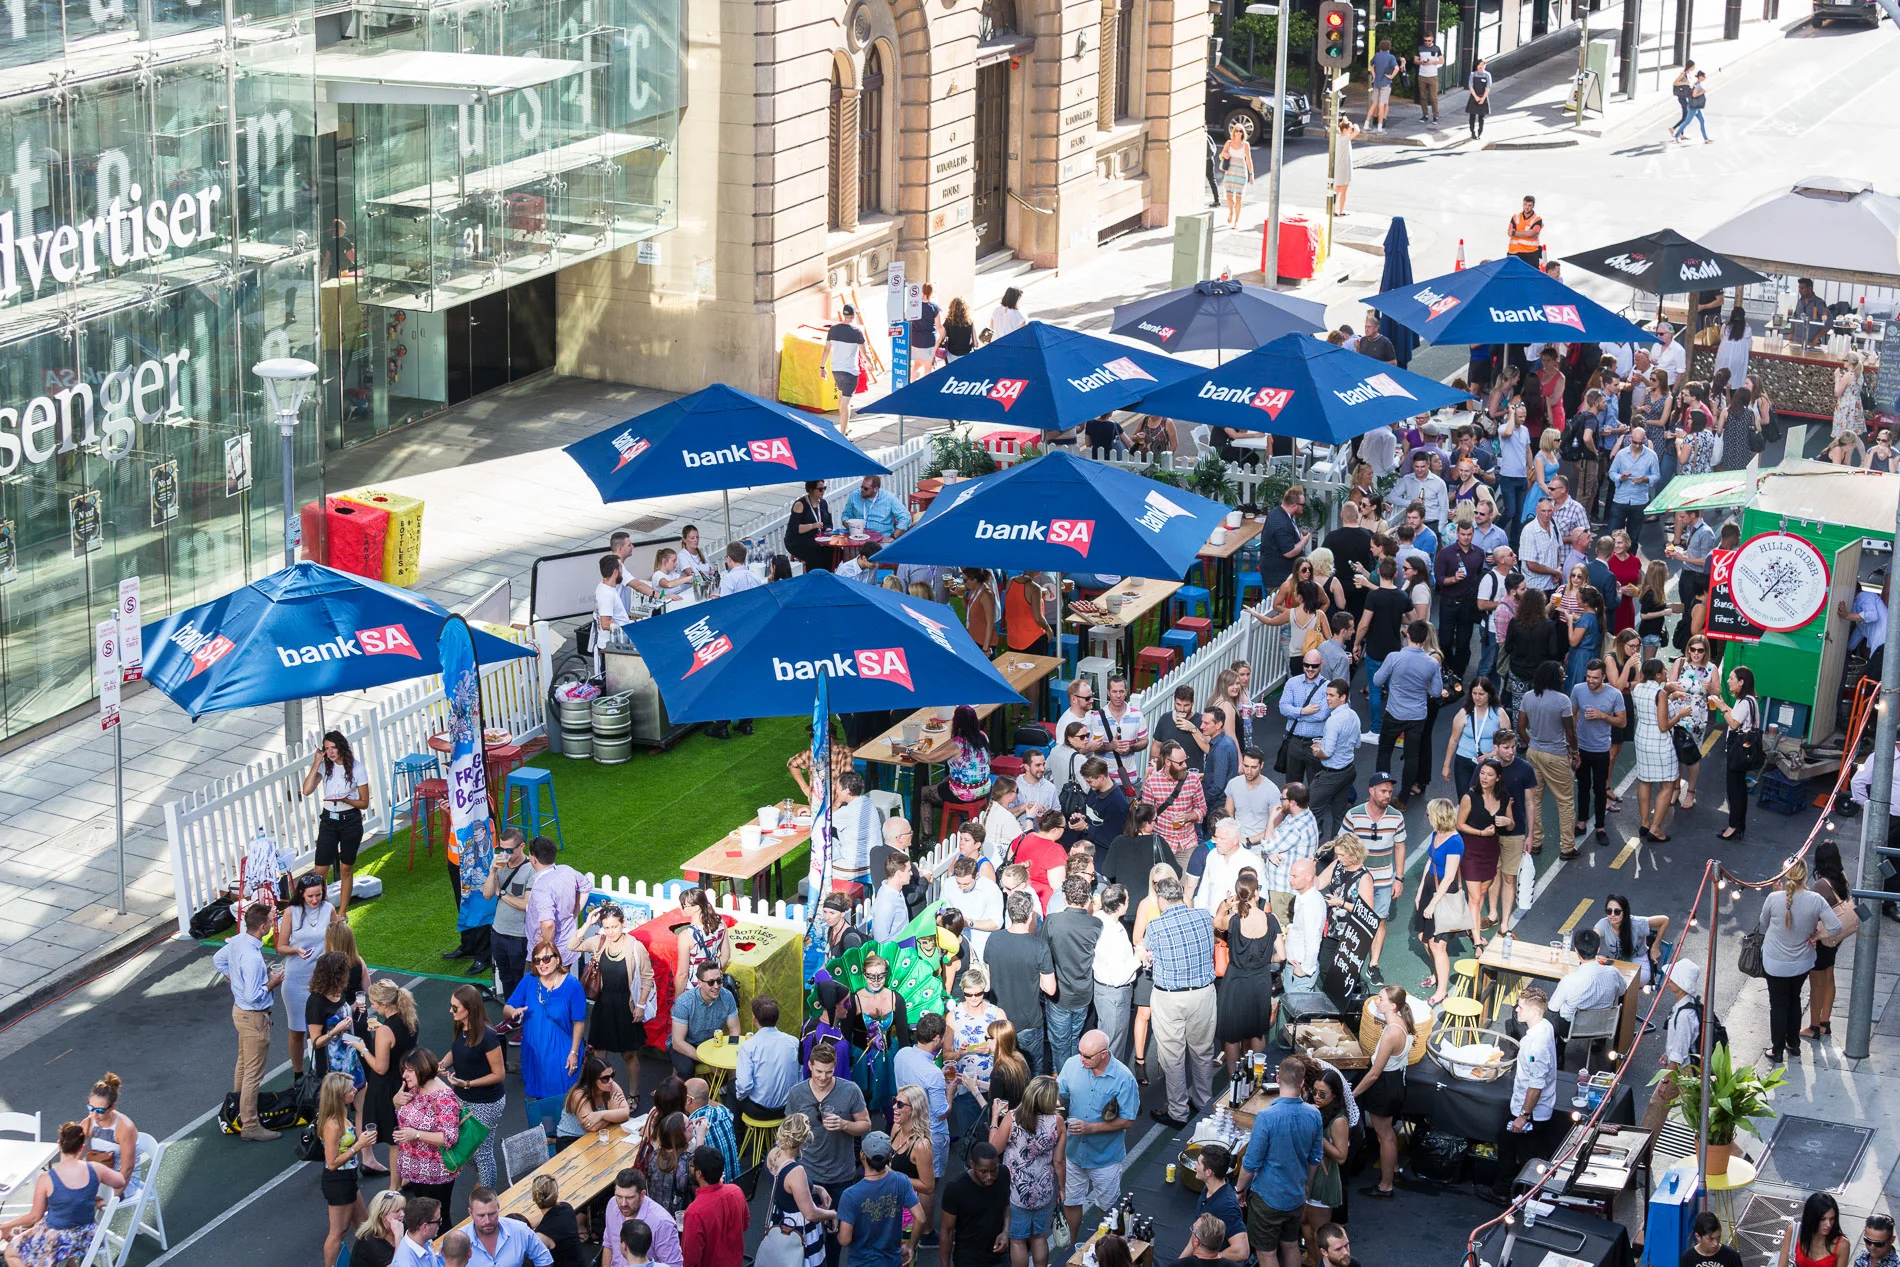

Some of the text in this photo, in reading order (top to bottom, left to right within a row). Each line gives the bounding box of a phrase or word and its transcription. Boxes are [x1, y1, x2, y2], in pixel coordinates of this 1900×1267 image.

[463, 224, 484, 256] 31
[1604, 253, 1654, 276] Asahi
[1680, 259, 1722, 281] Asahi
[1489, 306, 1579, 323] bankSA
[1138, 321, 1173, 338] bankSA
[940, 376, 1023, 399] bankSA
[1067, 359, 1144, 393] bankSA
[1198, 381, 1288, 408] bankSA
[0, 348, 190, 477] senger
[683, 442, 791, 468] bankSA
[974, 519, 1089, 542] bankSA
[1758, 541, 1793, 554] HILLS
[1794, 547, 1819, 577] CIDER
[169, 620, 225, 666] bankSA
[277, 627, 411, 668] bankSA
[683, 615, 732, 666] bankSA
[772, 651, 907, 681] bankSA
